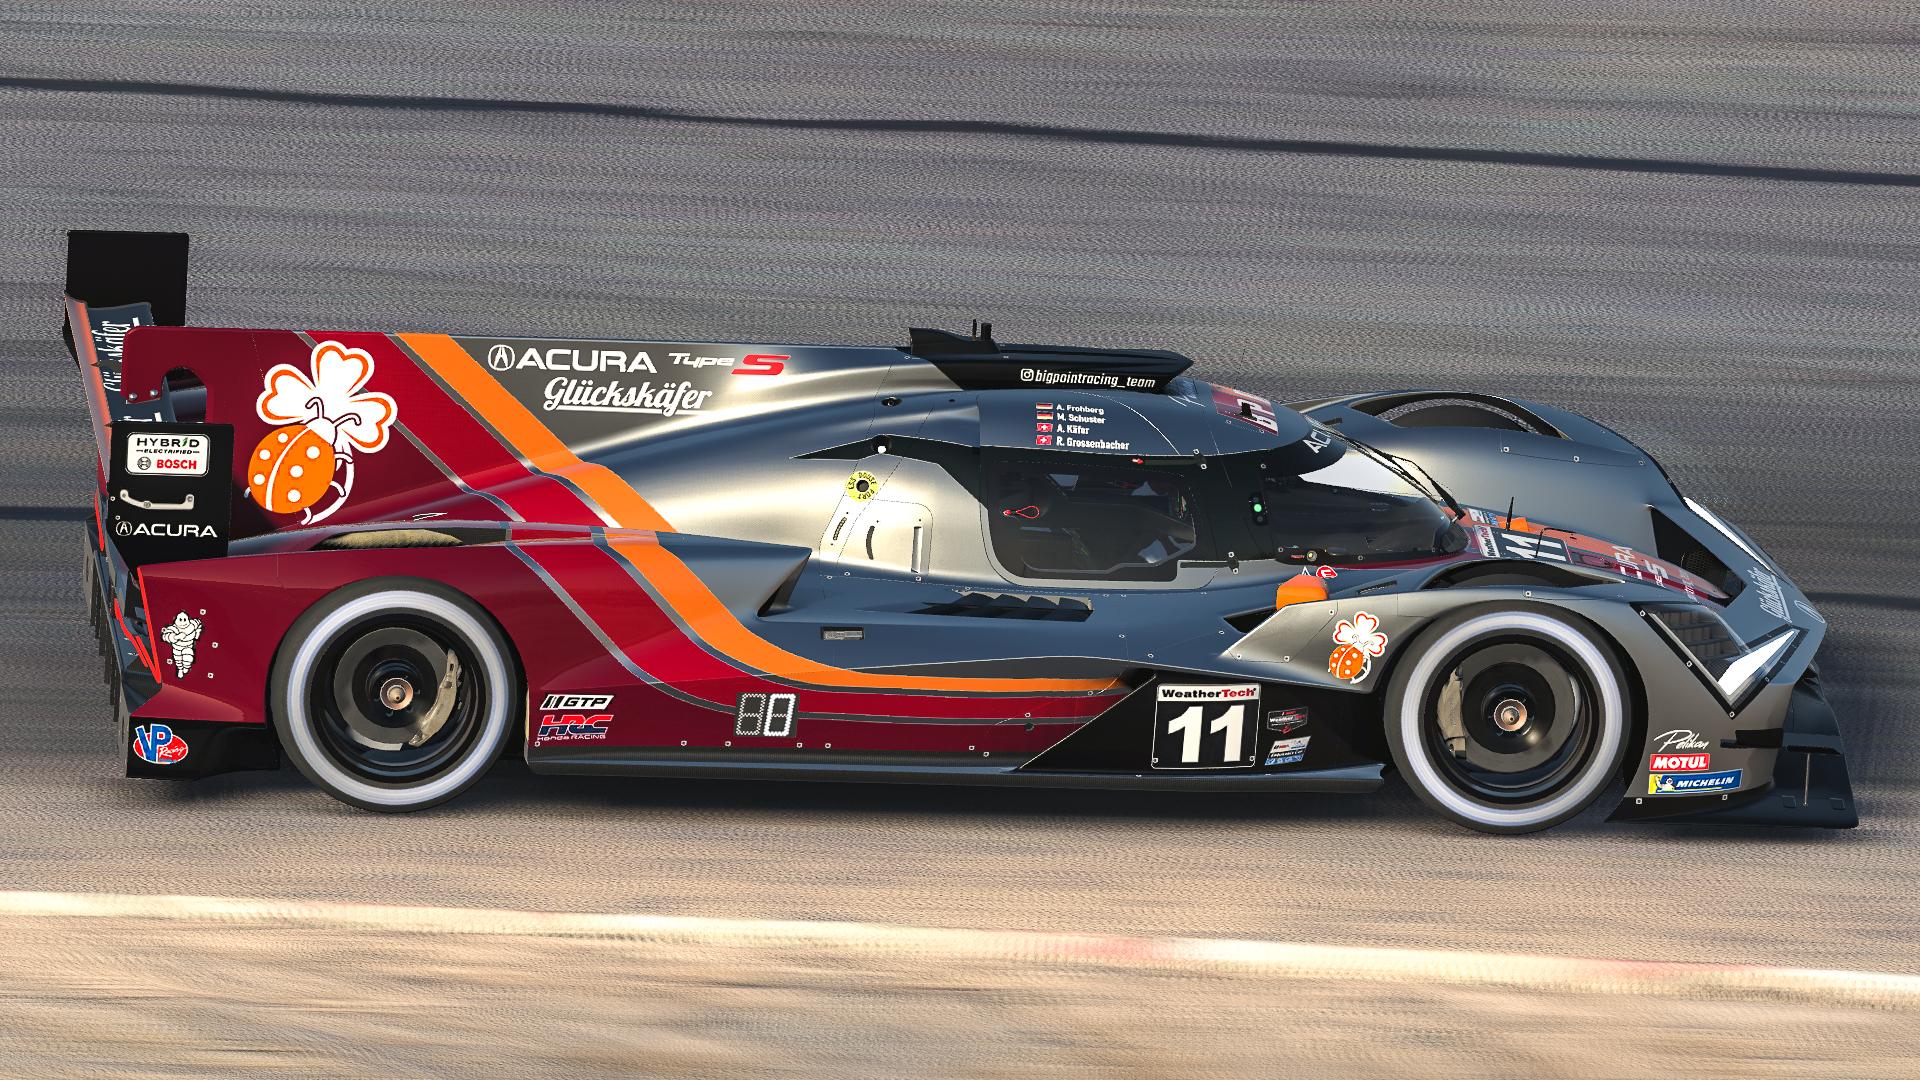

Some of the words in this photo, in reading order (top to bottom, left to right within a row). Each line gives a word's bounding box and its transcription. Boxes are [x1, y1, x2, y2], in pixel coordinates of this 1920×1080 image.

[516, 347, 657, 374] ACURA
[668, 352, 735, 369] Type
[731, 354, 790, 376] S
[1034, 369, 1156, 388] bigpointracing_team
[543, 376, 713, 417] Glückskäfer
[1066, 404, 1105, 415] Frohberg
[1068, 413, 1106, 424] Schuster
[1056, 423, 1066, 433] A.
[1066, 424, 1090, 435] Käfer
[1056, 435, 1065, 447] R.
[1066, 436, 1130, 450] Grossenbacher
[156, 459, 197, 469] BOSCH
[132, 523, 219, 538] ACURA
[1162, 687, 1257, 698] WeatherTech
[563, 696, 608, 707] GTP
[1168, 705, 1245, 763] 11
[135, 723, 173, 764] VP
[1652, 755, 1707, 769] MOTUL
[1676, 776, 1735, 788] MICHELIN
